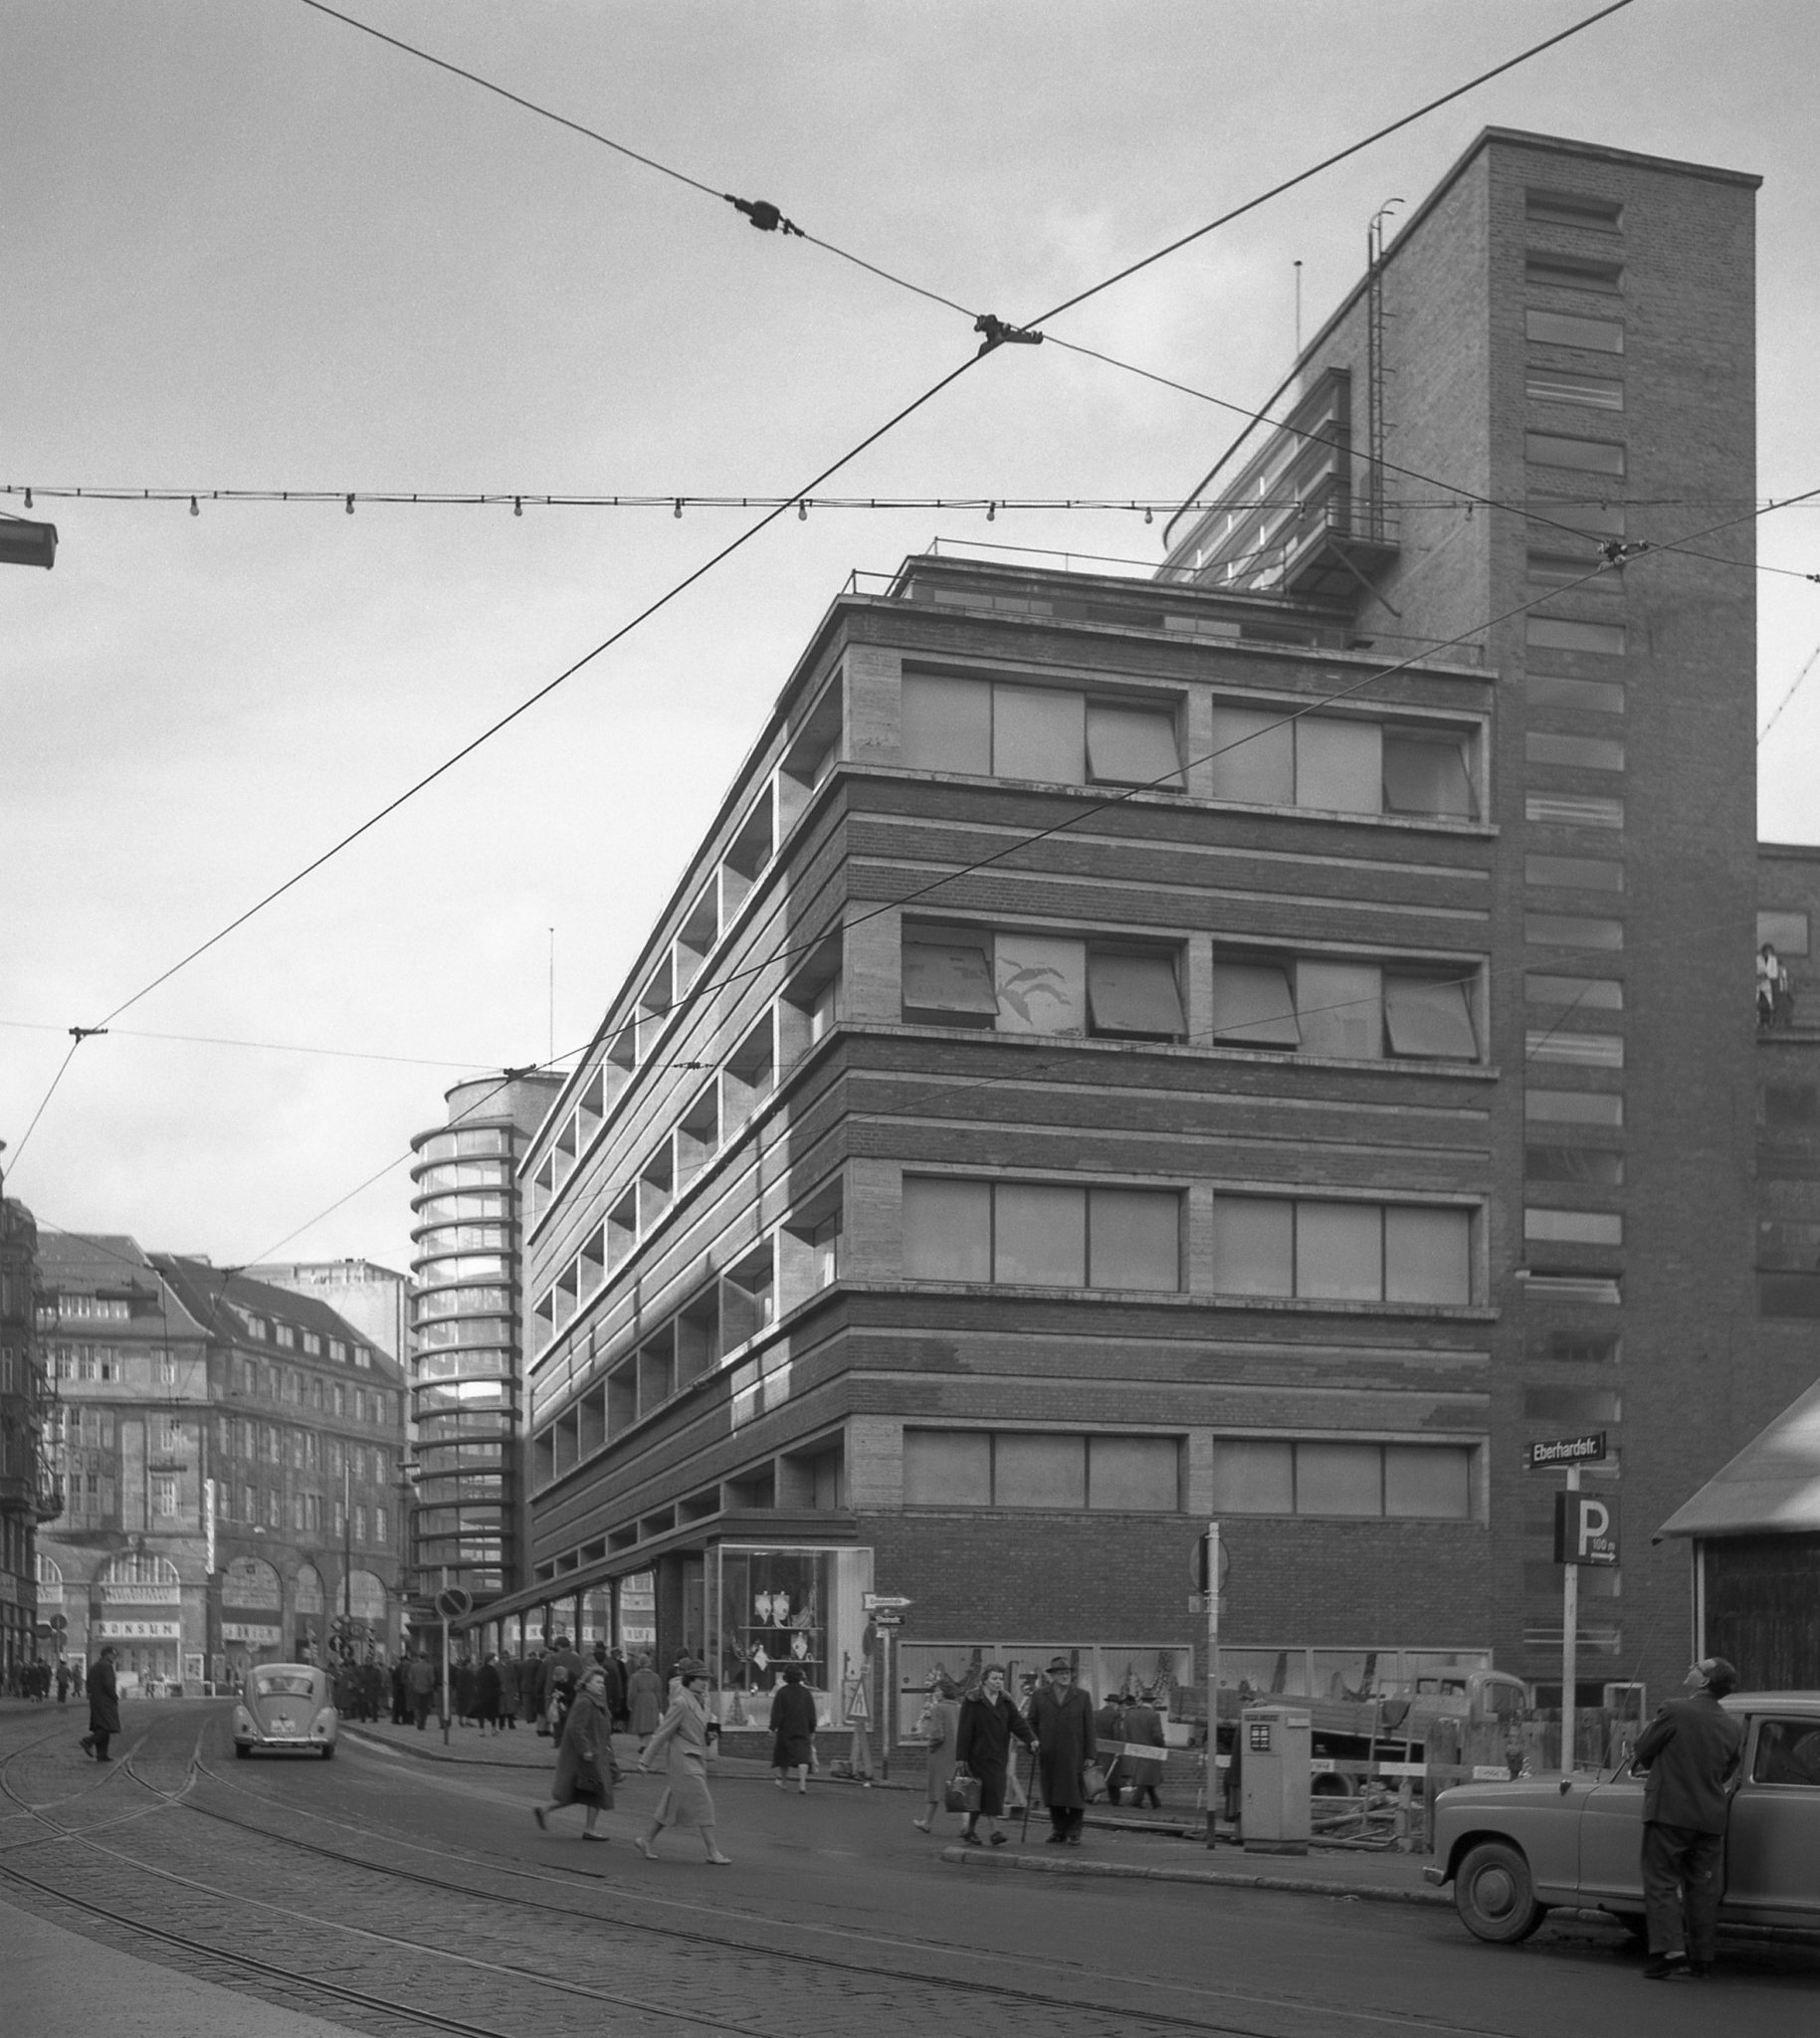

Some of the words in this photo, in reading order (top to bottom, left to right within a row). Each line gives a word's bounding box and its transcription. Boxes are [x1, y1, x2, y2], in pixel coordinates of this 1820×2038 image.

[1533, 1437, 1598, 1462] Eberhardstr.
[1578, 1500, 1609, 1556] P
[1592, 1537, 1607, 1550] 100
[1607, 1541, 1616, 1551] m
[99, 1623, 172, 1634] KONSUM
